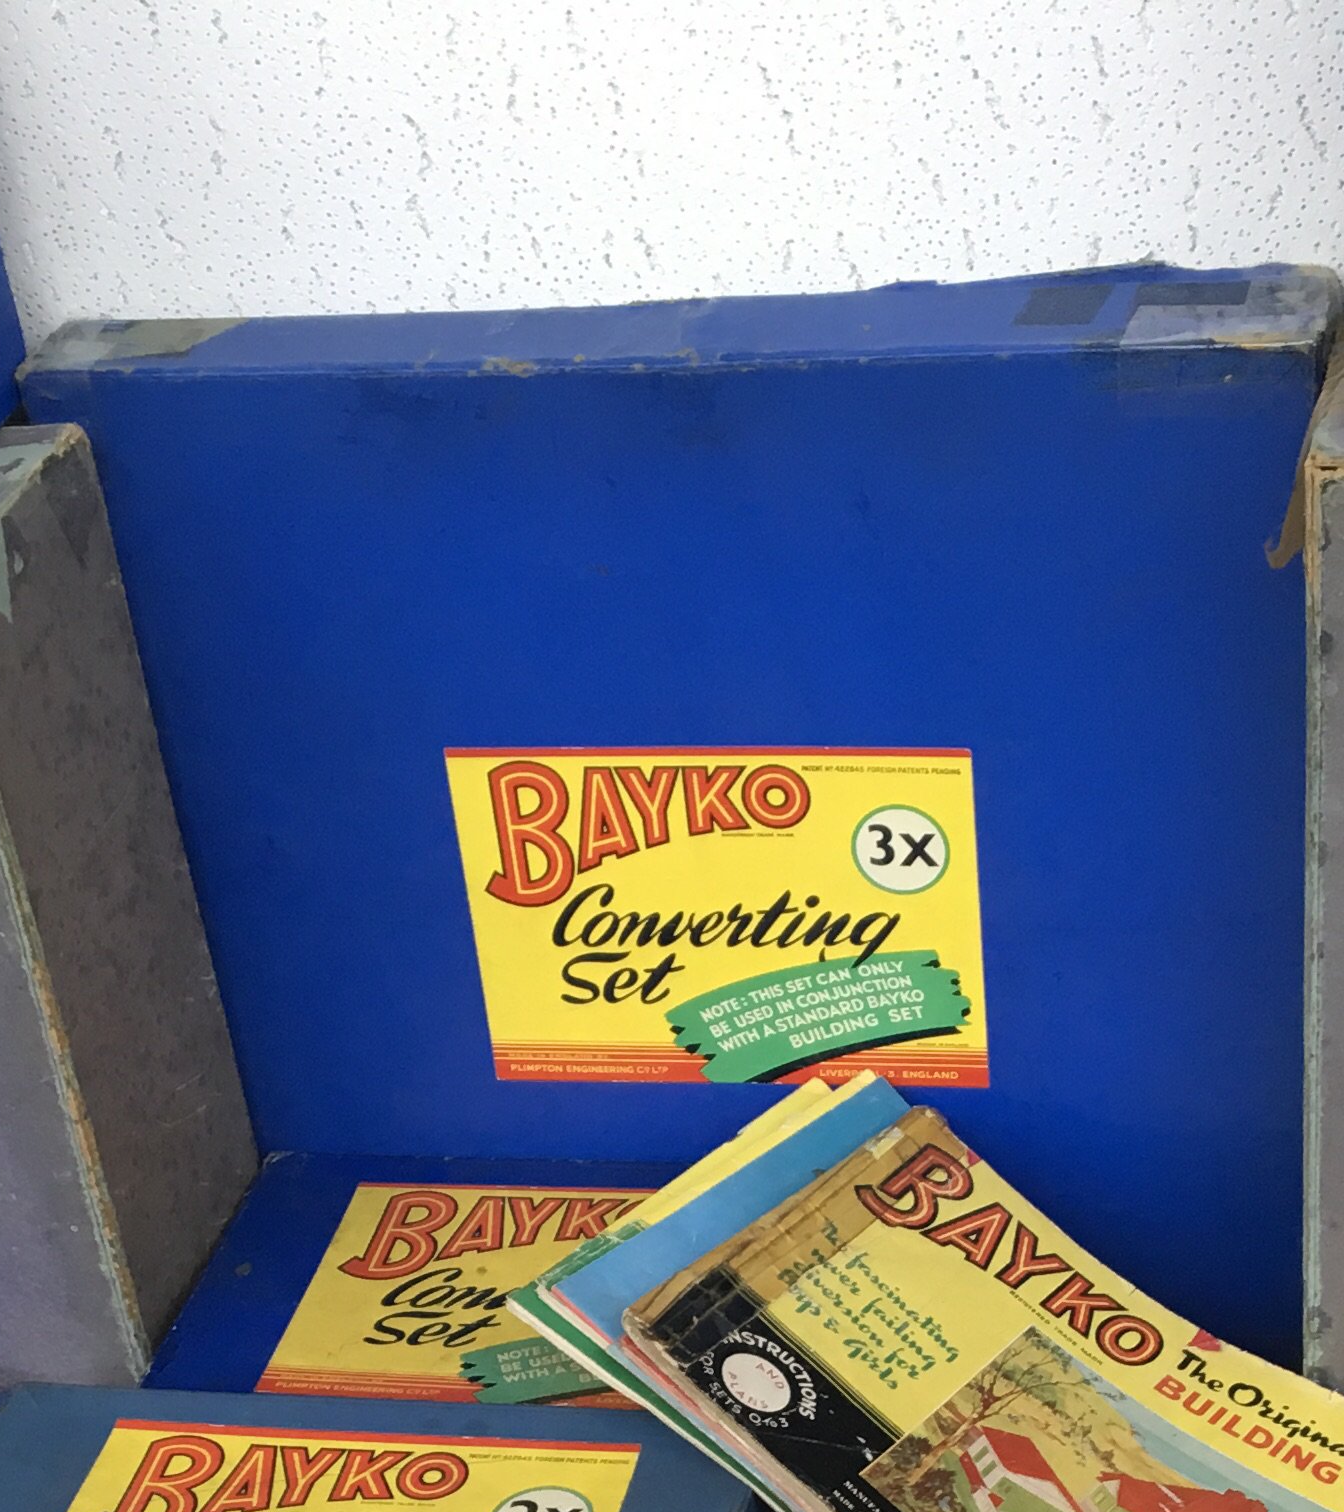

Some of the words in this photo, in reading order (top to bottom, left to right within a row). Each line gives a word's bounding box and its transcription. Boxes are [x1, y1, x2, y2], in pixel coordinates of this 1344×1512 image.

[485, 760, 811, 907] BAYKO
[552, 884, 901, 966] Converting
[560, 951, 685, 1004] Set
[338, 1190, 648, 1280] BAYK
[855, 1142, 1164, 1371] BAYKO
[364, 1311, 501, 1348] Set
[811, 1249, 861, 1296] never
[862, 1298, 936, 1370] failing
[846, 1252, 958, 1362] fascinating
[709, 1382, 742, 1414] SETS
[724, 1329, 816, 1420] INSTRUCTIONS
[755, 1363, 784, 1389] AND
[843, 1339, 898, 1390] Girls
[884, 1348, 920, 1380] for
[1177, 1350, 1223, 1392] The
[1153, 1375, 1342, 1485] BUILDING
